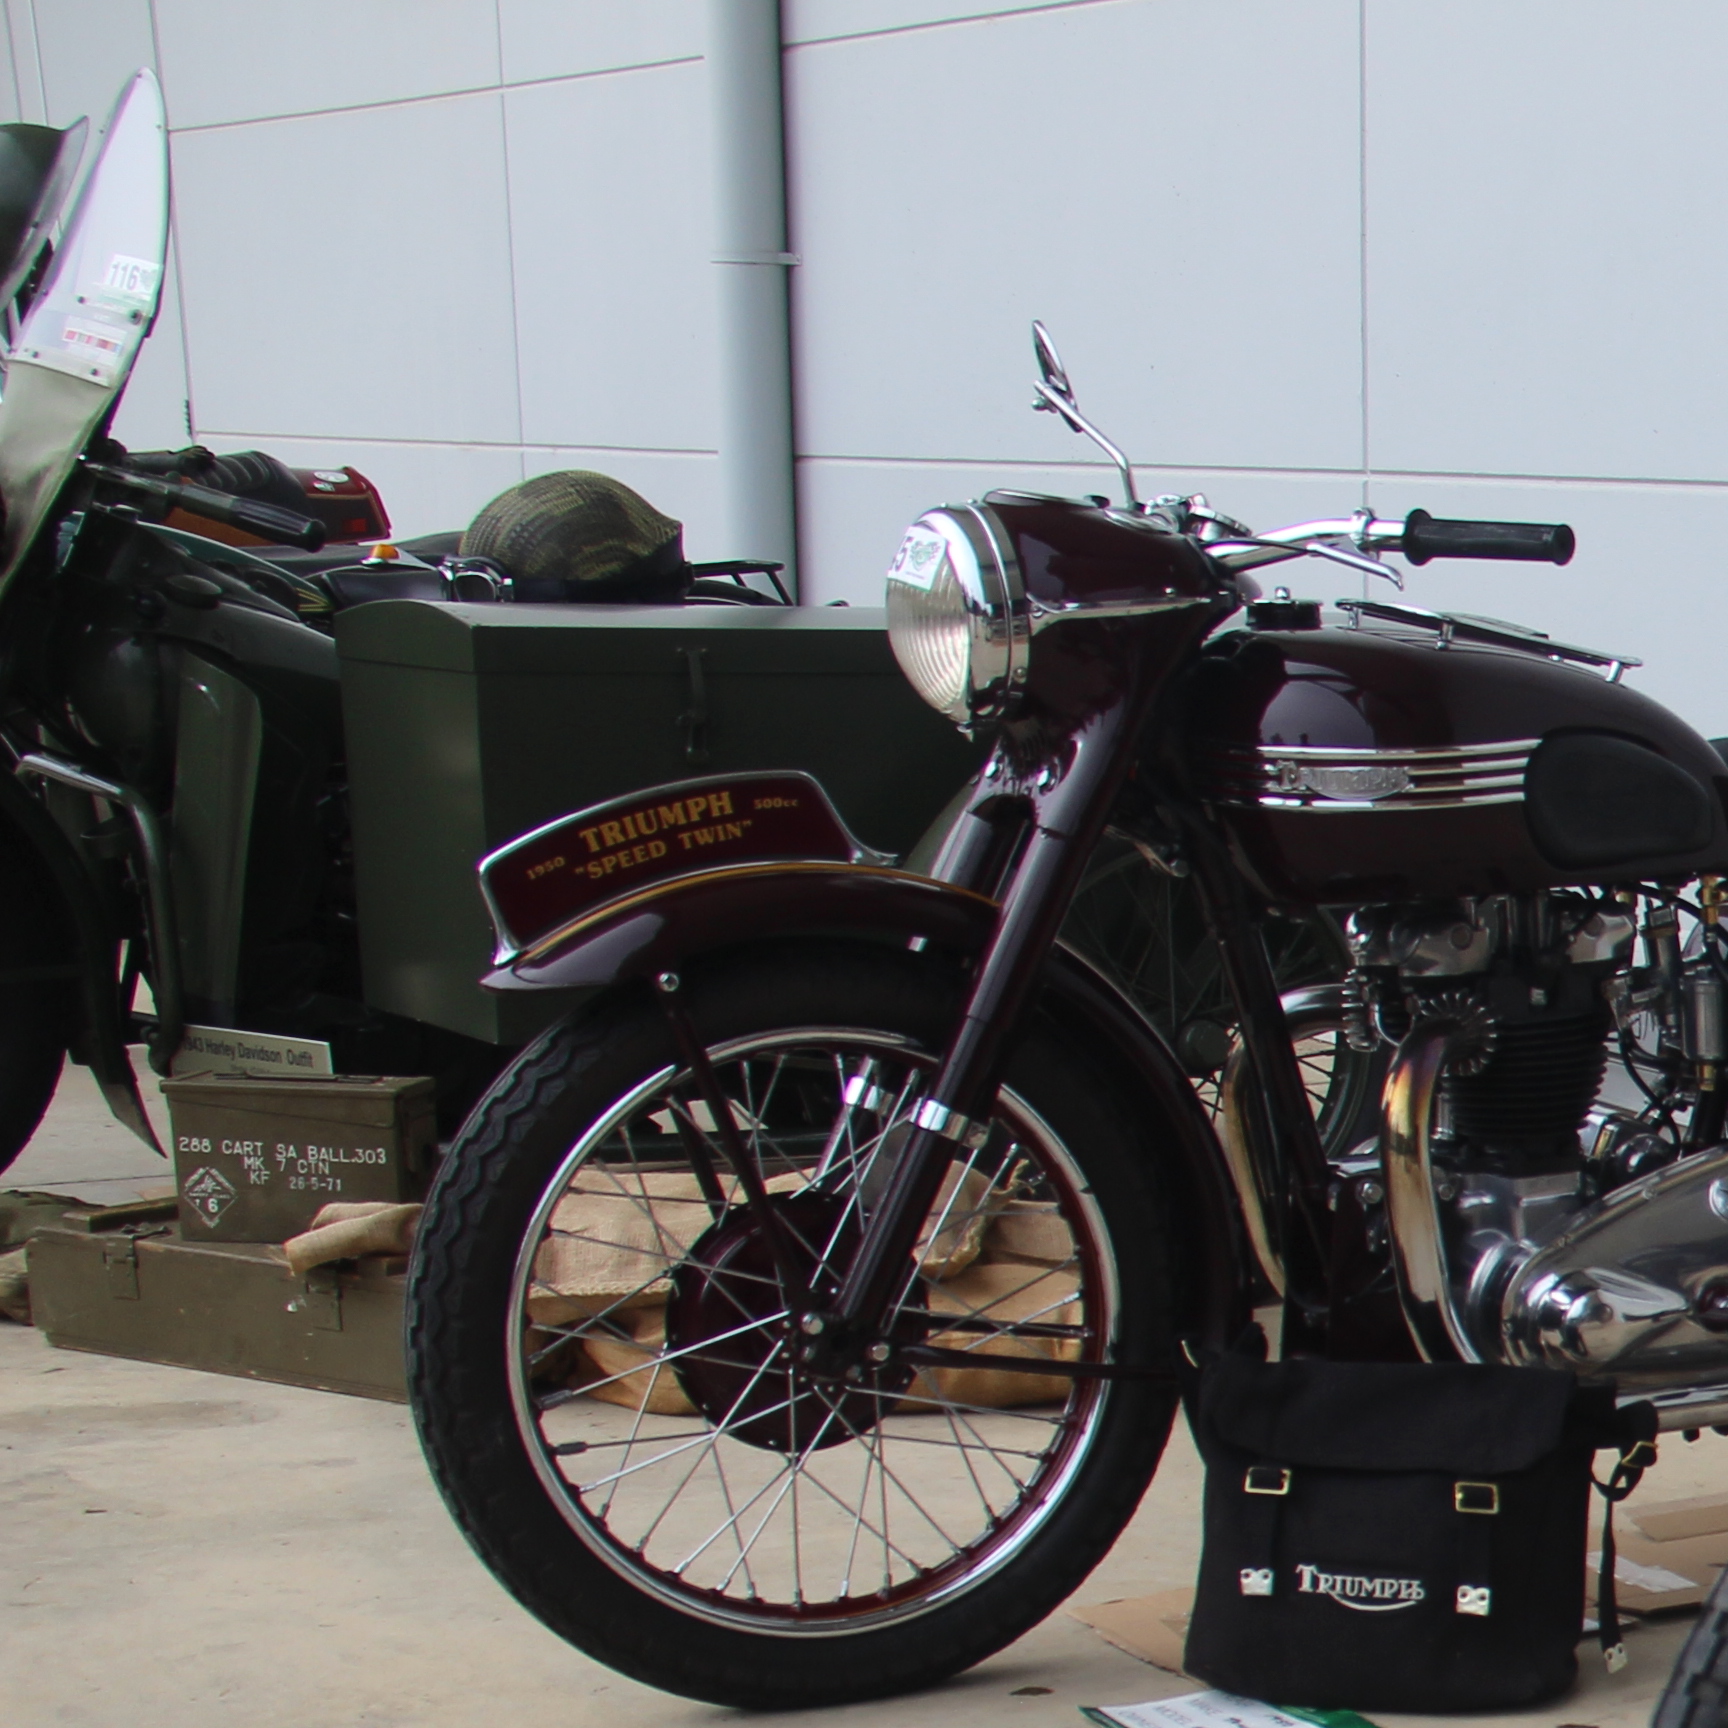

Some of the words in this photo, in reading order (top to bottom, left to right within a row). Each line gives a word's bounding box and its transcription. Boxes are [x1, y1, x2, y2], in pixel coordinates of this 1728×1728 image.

[111, 261, 140, 290] 116
[753, 797, 798, 810] 500cc
[578, 790, 734, 853] TRIUMPH
[525, 855, 566, 880] 1950
[205, 1037, 236, 1060] Harley
[237, 1042, 283, 1064] Davidson
[286, 1048, 314, 1068] Outfit
[179, 1136, 211, 1154] 288
[221, 1139, 264, 1156] CART
[275, 1143, 298, 1160] SA
[244, 1156, 265, 1171] MK
[276, 1157, 287, 1172] 7
[297, 1160, 330, 1175] CTN
[249, 1170, 271, 1185] KF
